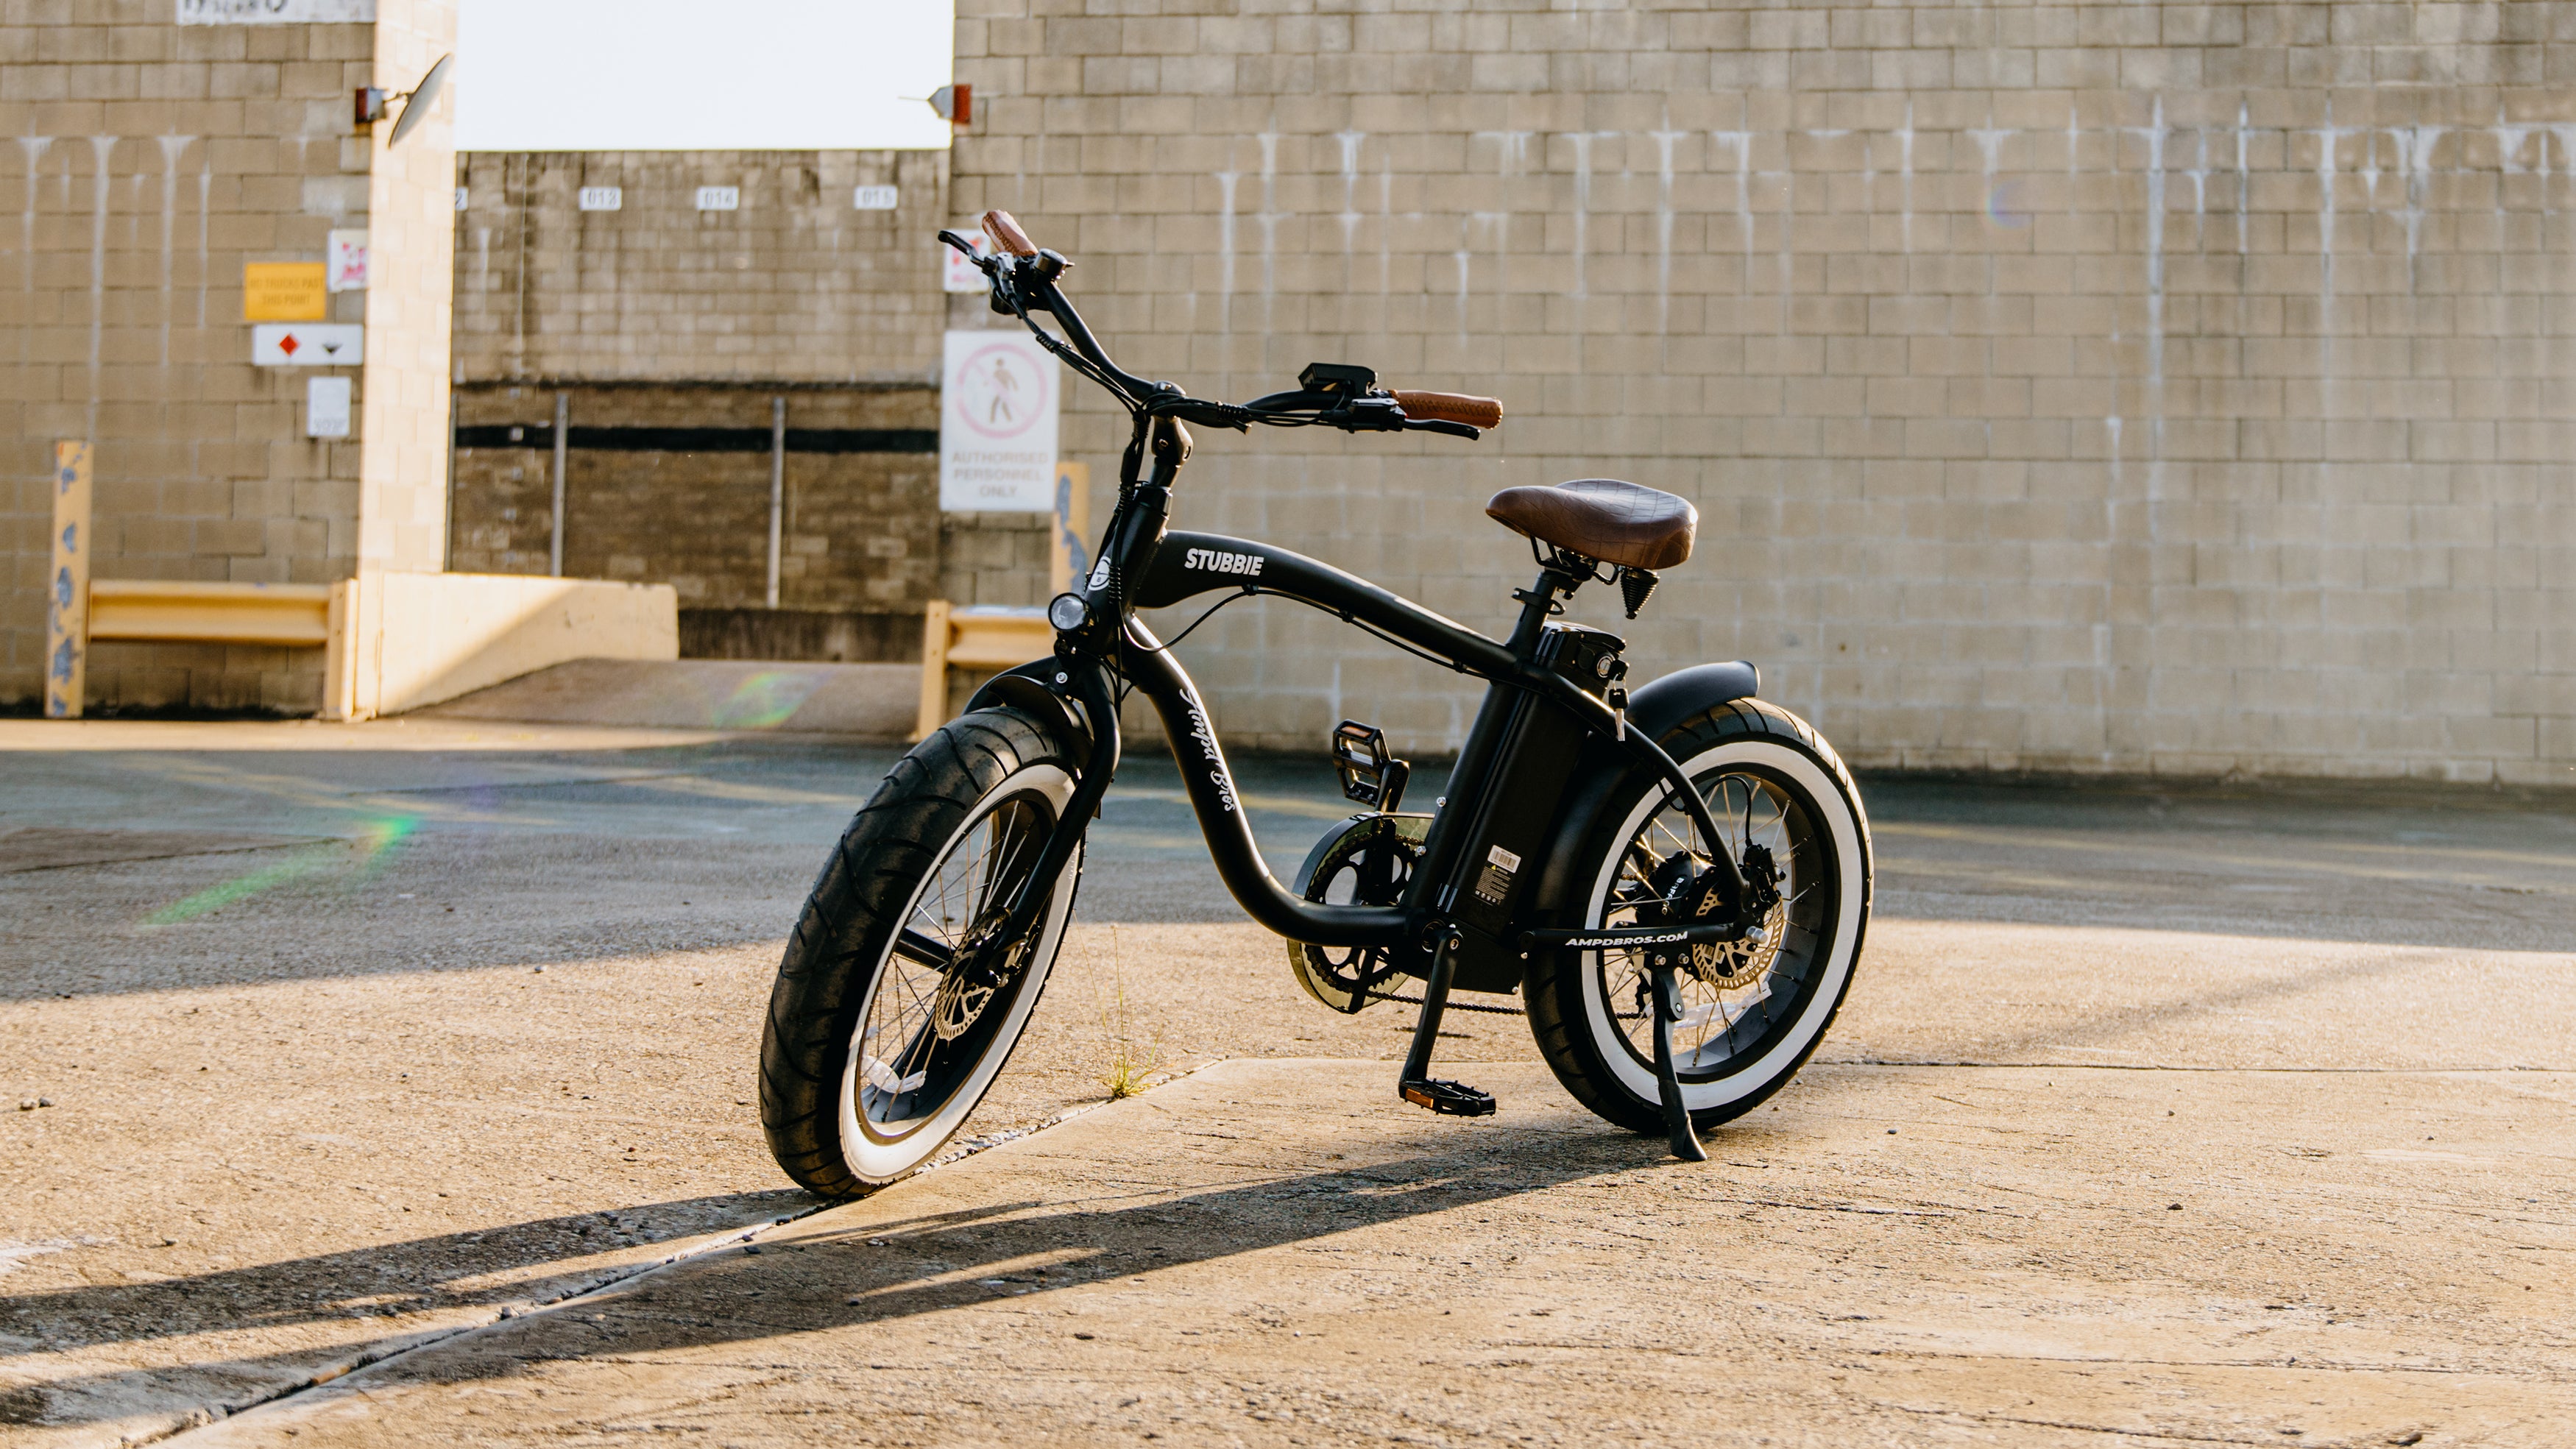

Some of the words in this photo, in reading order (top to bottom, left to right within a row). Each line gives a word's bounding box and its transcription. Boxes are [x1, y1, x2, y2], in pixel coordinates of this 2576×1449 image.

[952, 451, 1048, 464] AUTHORISED
[953, 468, 1044, 481] PERSONNEL
[979, 485, 1018, 498] ONLY
[1184, 548, 1264, 576] STUBBIE
[1210, 763, 1236, 812] Bros
[1565, 931, 1688, 946] AMPDBROS.COM
